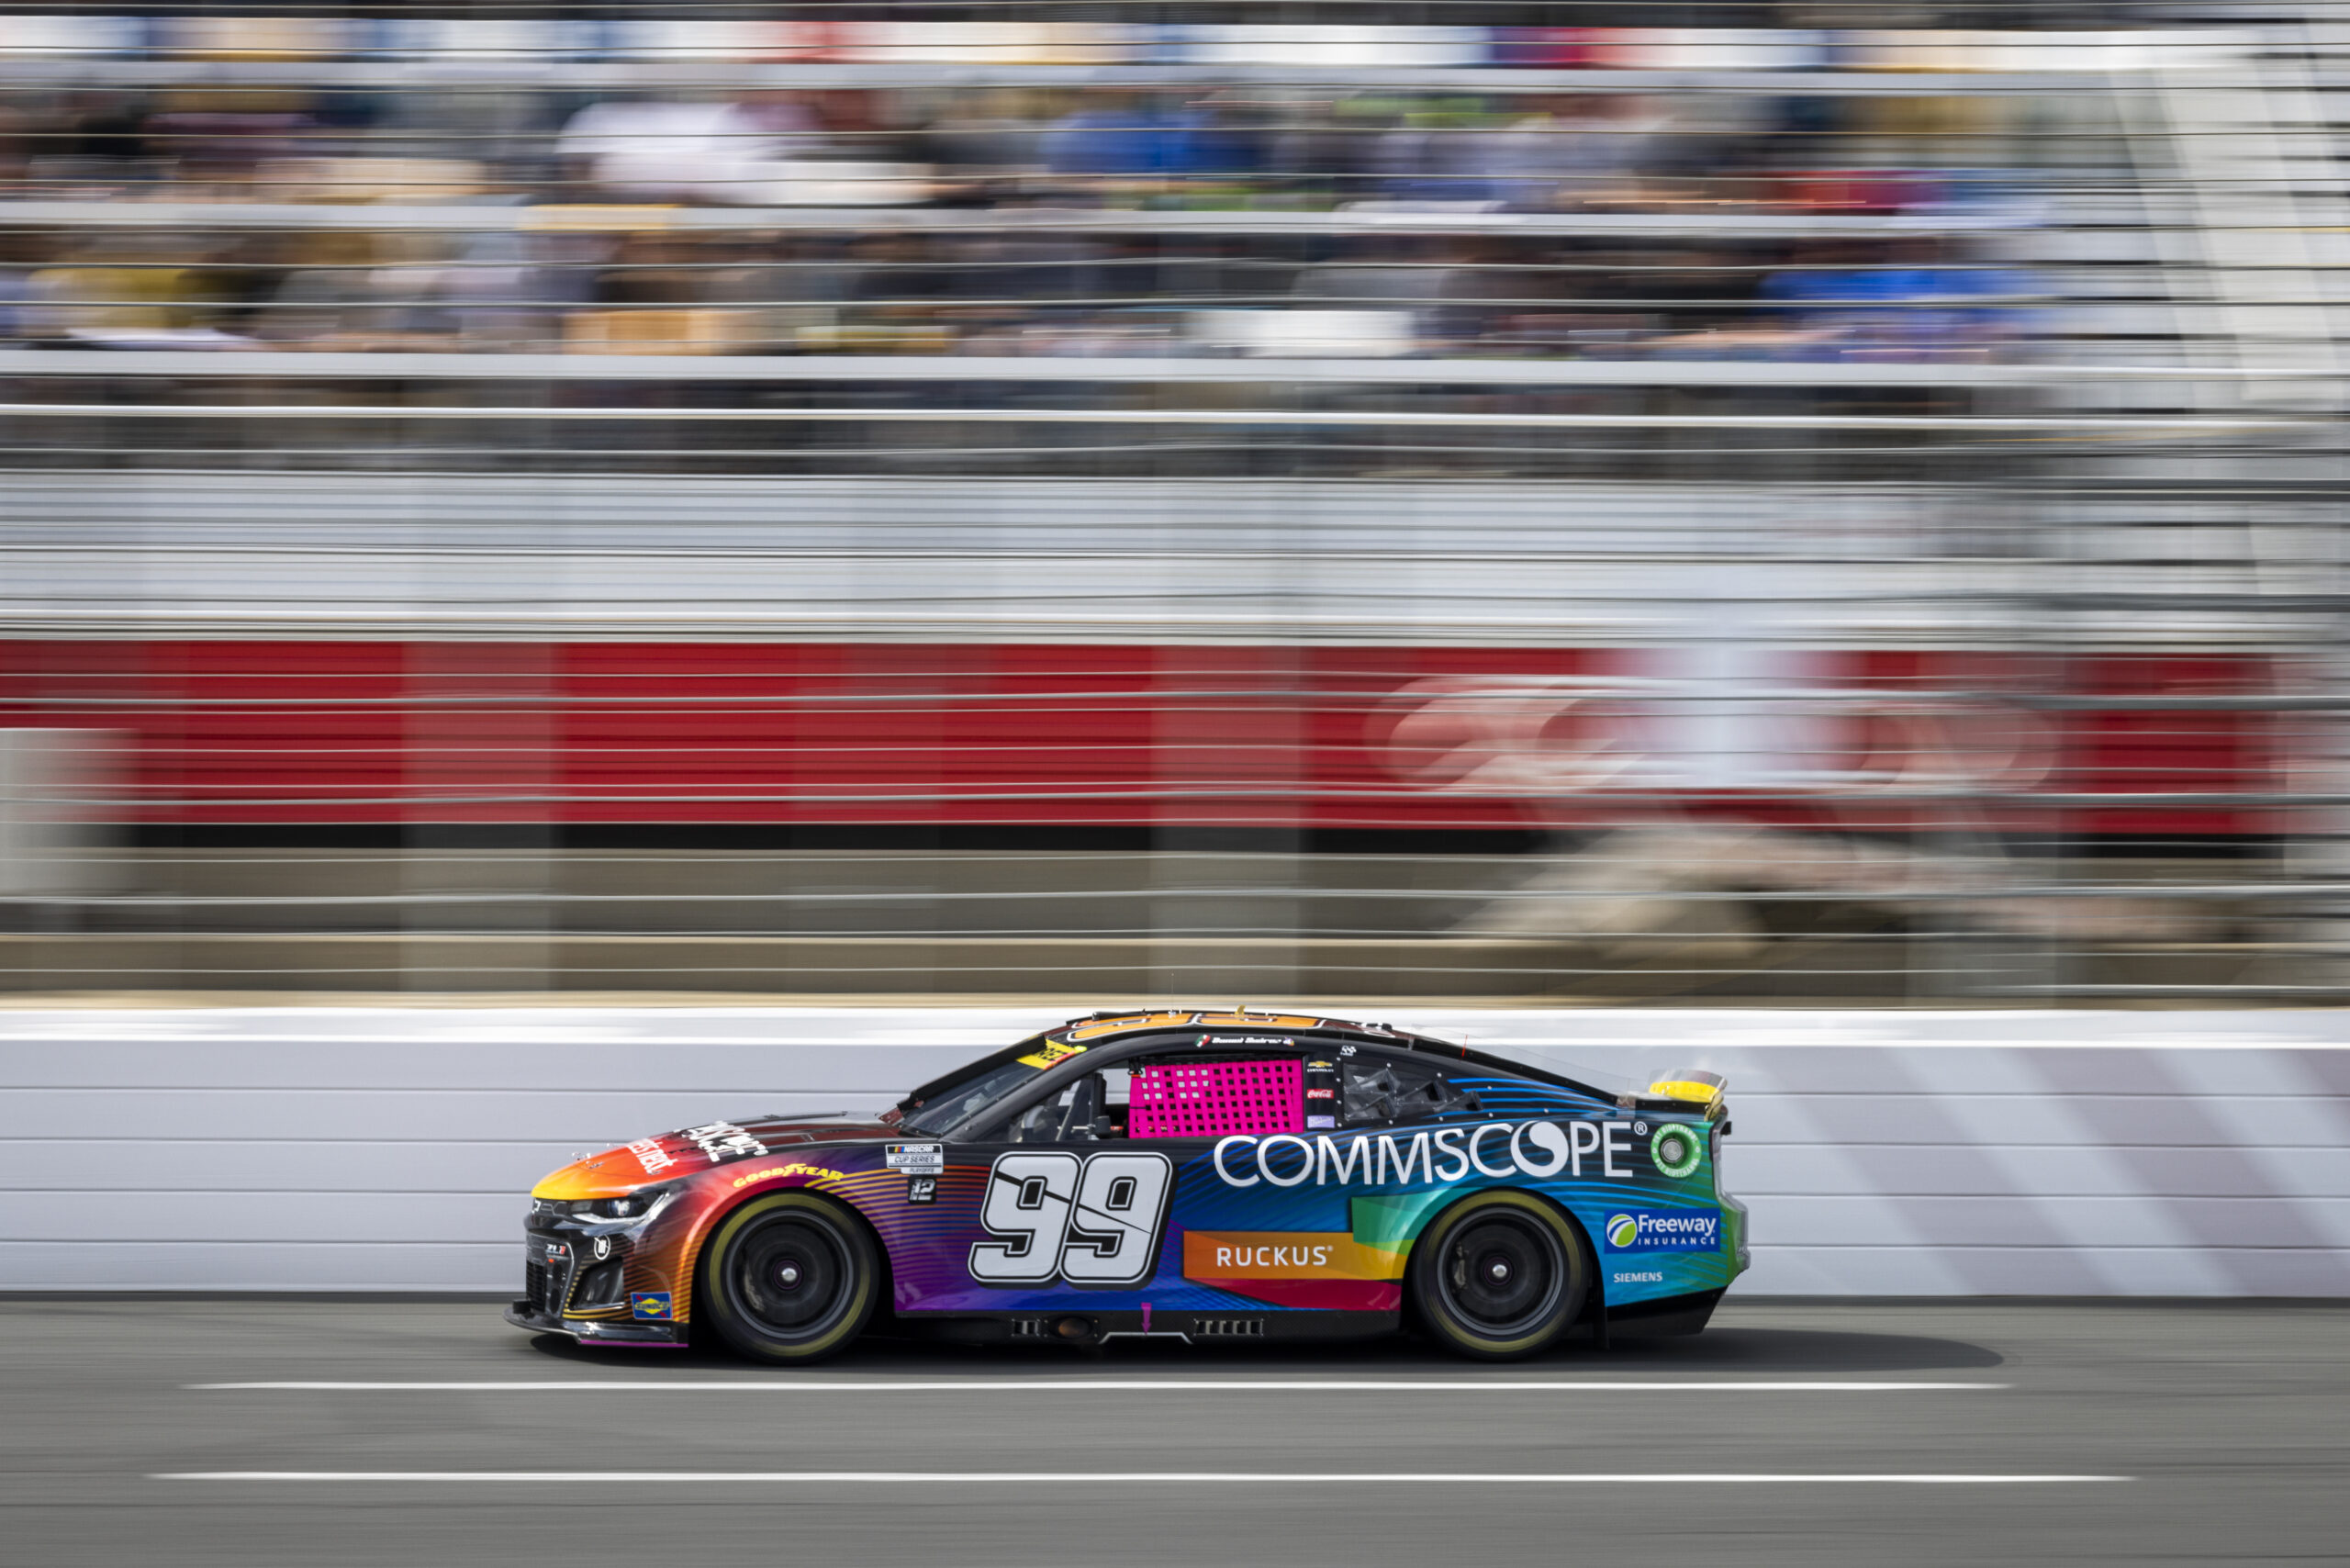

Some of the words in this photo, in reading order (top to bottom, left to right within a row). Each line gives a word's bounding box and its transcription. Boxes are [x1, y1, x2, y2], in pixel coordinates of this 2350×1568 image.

[733, 1163, 845, 1188] GOODYEAR
[968, 1151, 1174, 1285] 99
[1638, 1214, 1717, 1237] Freeway
[1638, 1237, 1716, 1246] INSURANCE
[1613, 1271, 1663, 1283] SIEMENS
